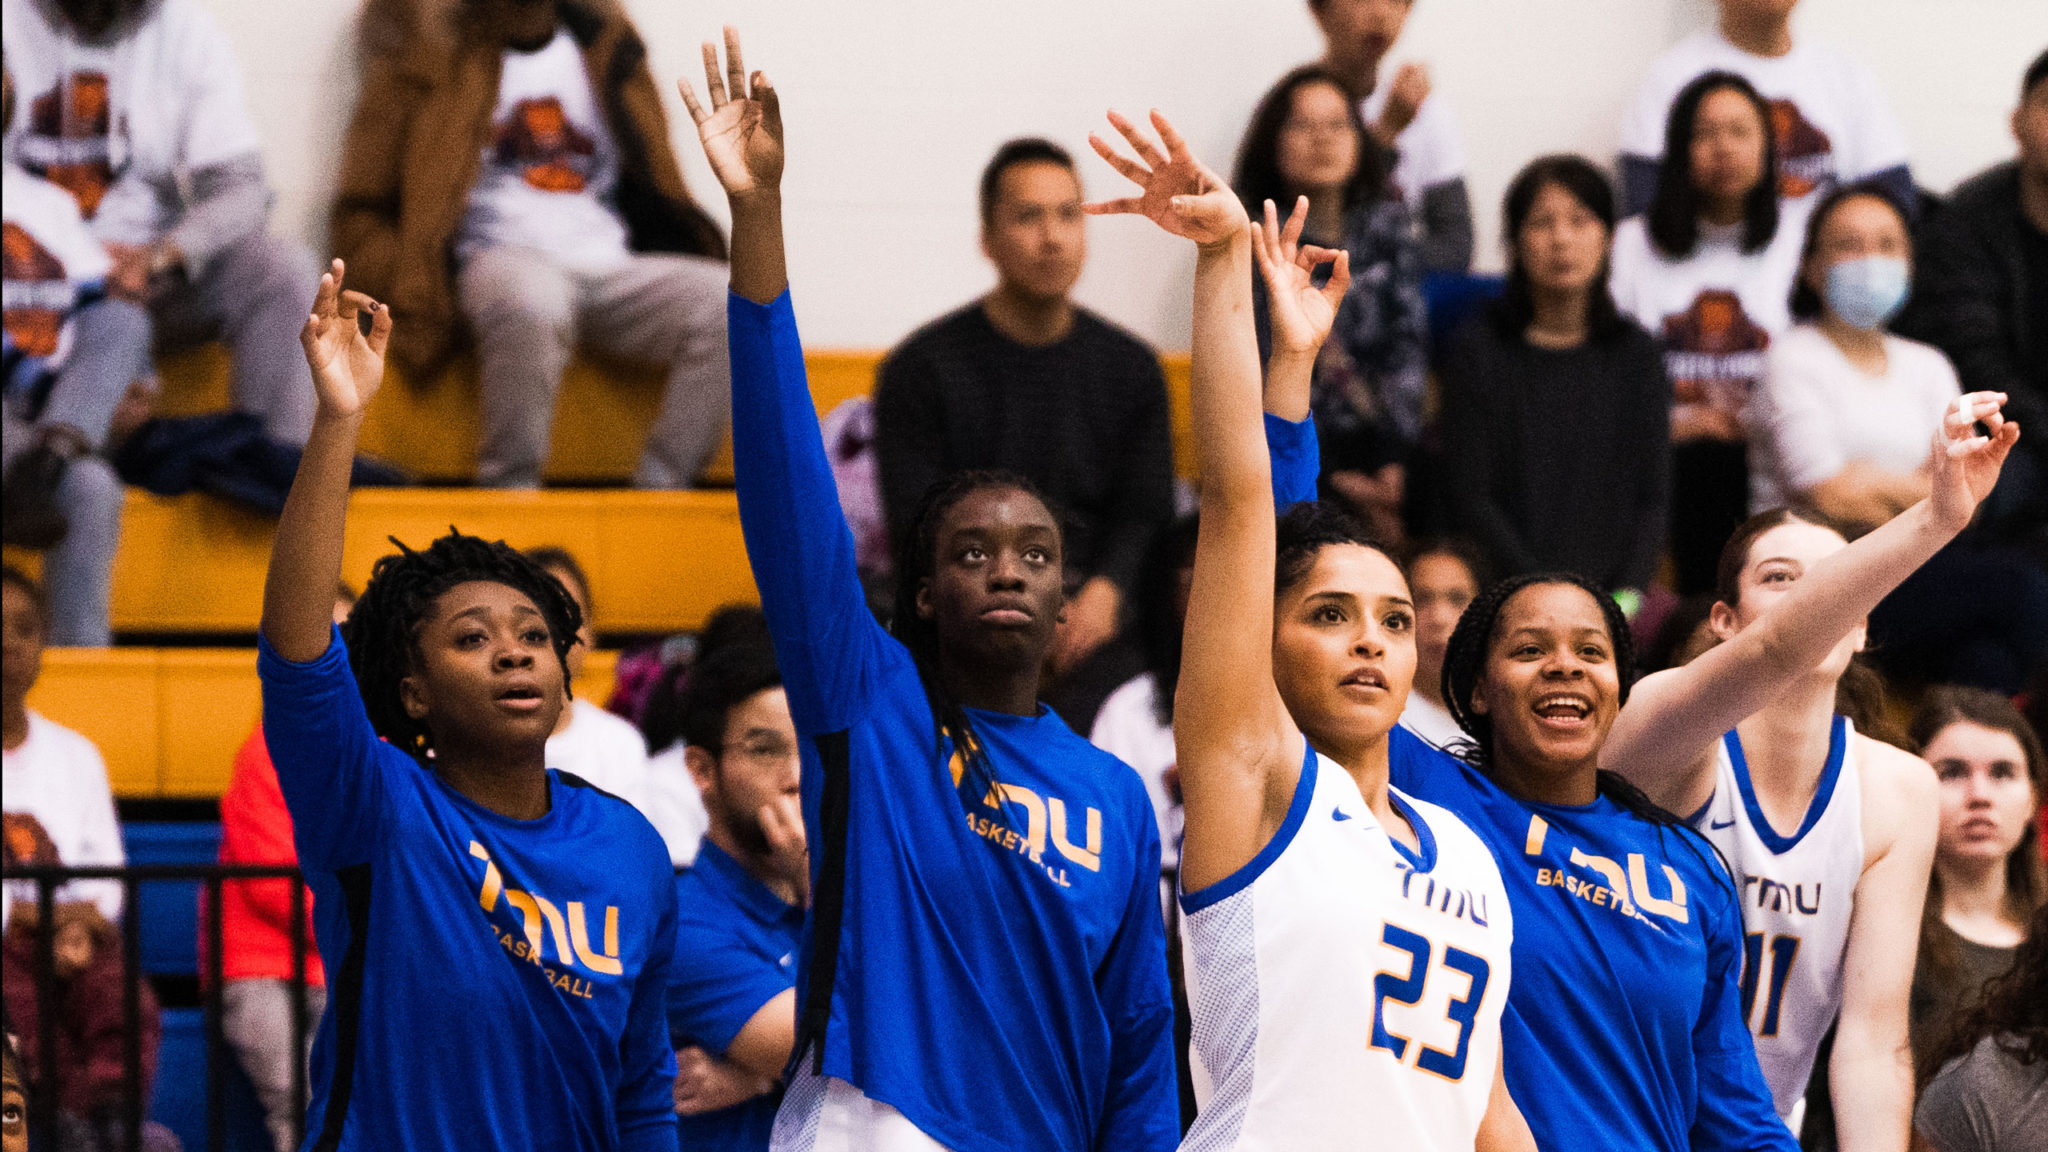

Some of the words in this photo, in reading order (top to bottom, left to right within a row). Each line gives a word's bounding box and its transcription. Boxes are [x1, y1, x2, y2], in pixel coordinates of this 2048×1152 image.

[1394, 861, 1489, 928] TMU
[1366, 919, 1491, 1084] 23
[1742, 930, 1801, 1038] 11
